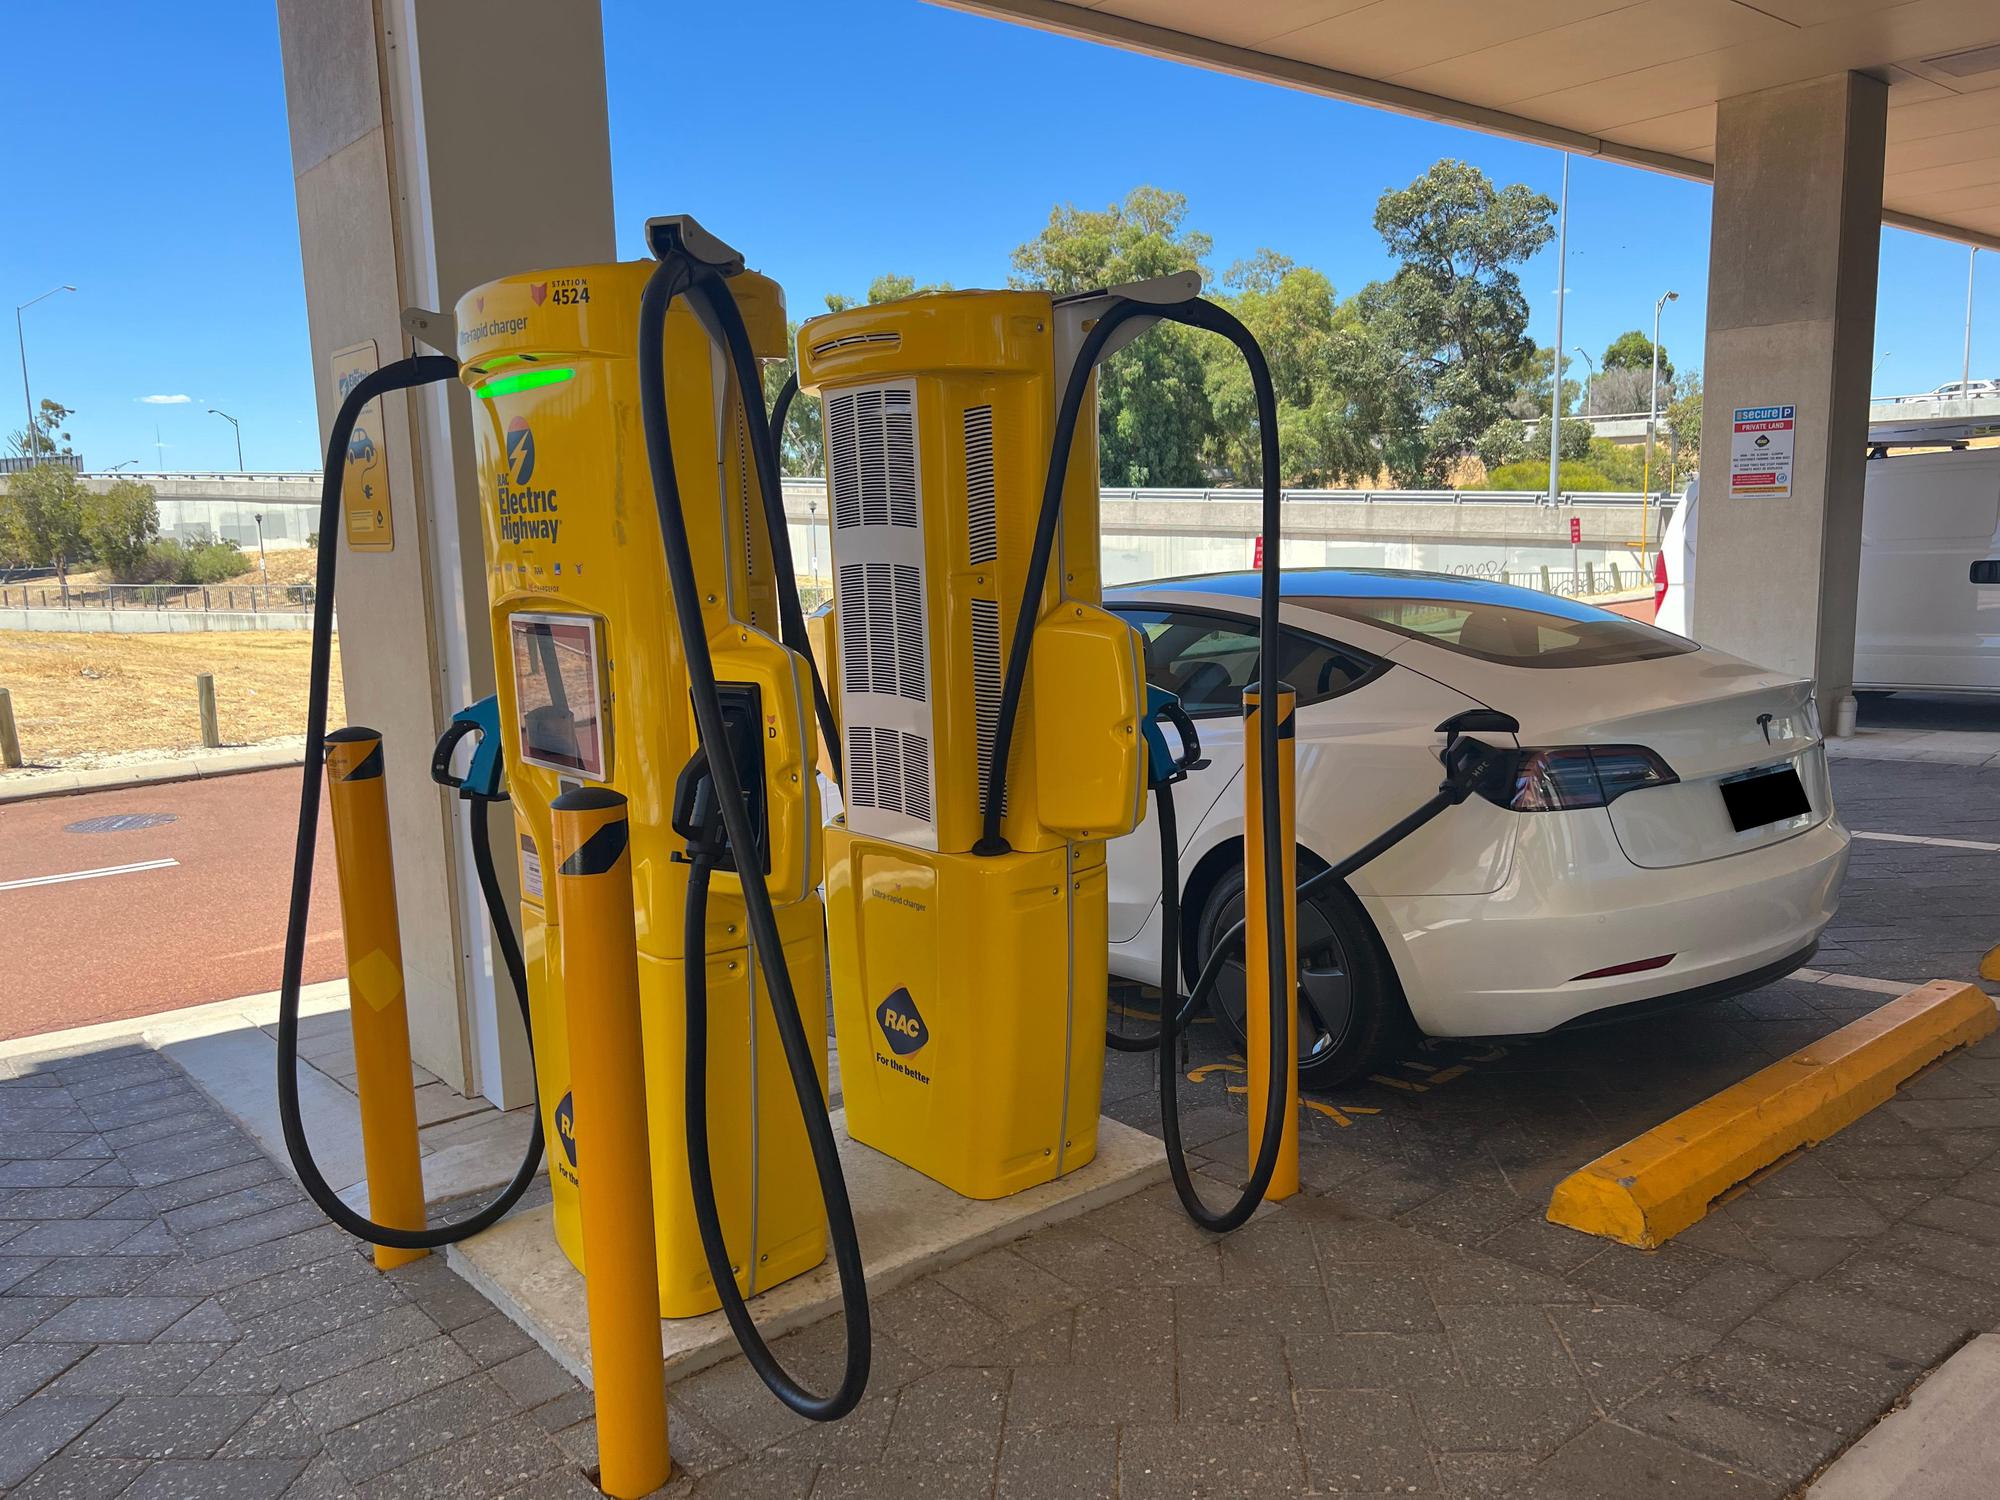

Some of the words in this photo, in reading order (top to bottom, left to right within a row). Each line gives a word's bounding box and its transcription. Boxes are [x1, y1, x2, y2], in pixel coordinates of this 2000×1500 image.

[552, 279, 587, 287] STATION
[552, 287, 591, 306] 4524
[489, 316, 529, 336] charger
[1743, 408, 1779, 419] secure
[1784, 408, 1791, 417] P
[498, 486, 558, 515] Electric
[500, 515, 559, 545] Highway
[768, 727, 777, 739] D
[1471, 760, 1489, 777] HPC
[902, 898, 927, 913] charger
[884, 1008, 920, 1038] RAC
[876, 1051, 890, 1067] For
[890, 1059, 904, 1073] the
[904, 1064, 930, 1085] better
[558, 1162, 568, 1178] For
